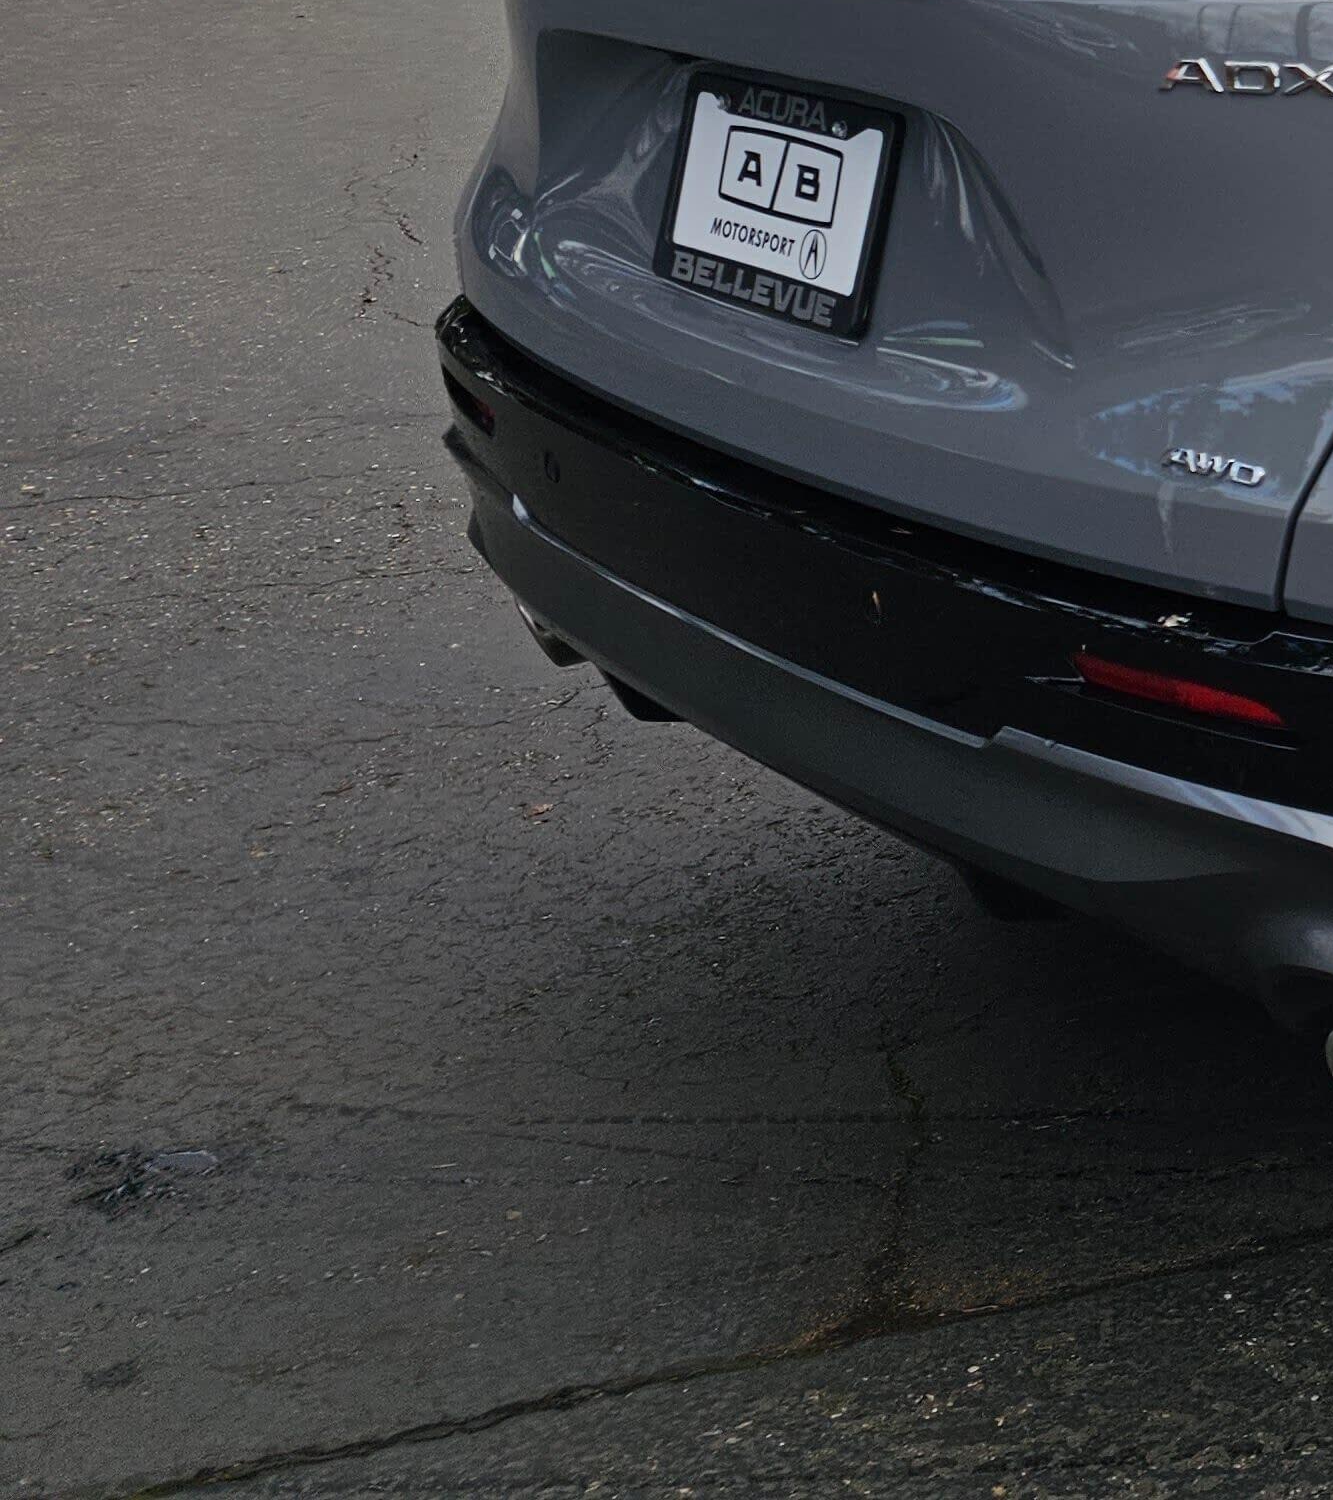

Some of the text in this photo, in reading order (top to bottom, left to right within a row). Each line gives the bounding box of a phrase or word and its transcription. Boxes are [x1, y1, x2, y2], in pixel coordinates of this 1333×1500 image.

[738, 86, 827, 132] ACURA
[737, 150, 821, 202] A B
[710, 217, 796, 257] MOTORSPORT
[671, 250, 837, 328] BELLEVUE
[1162, 447, 1266, 485] AWD
